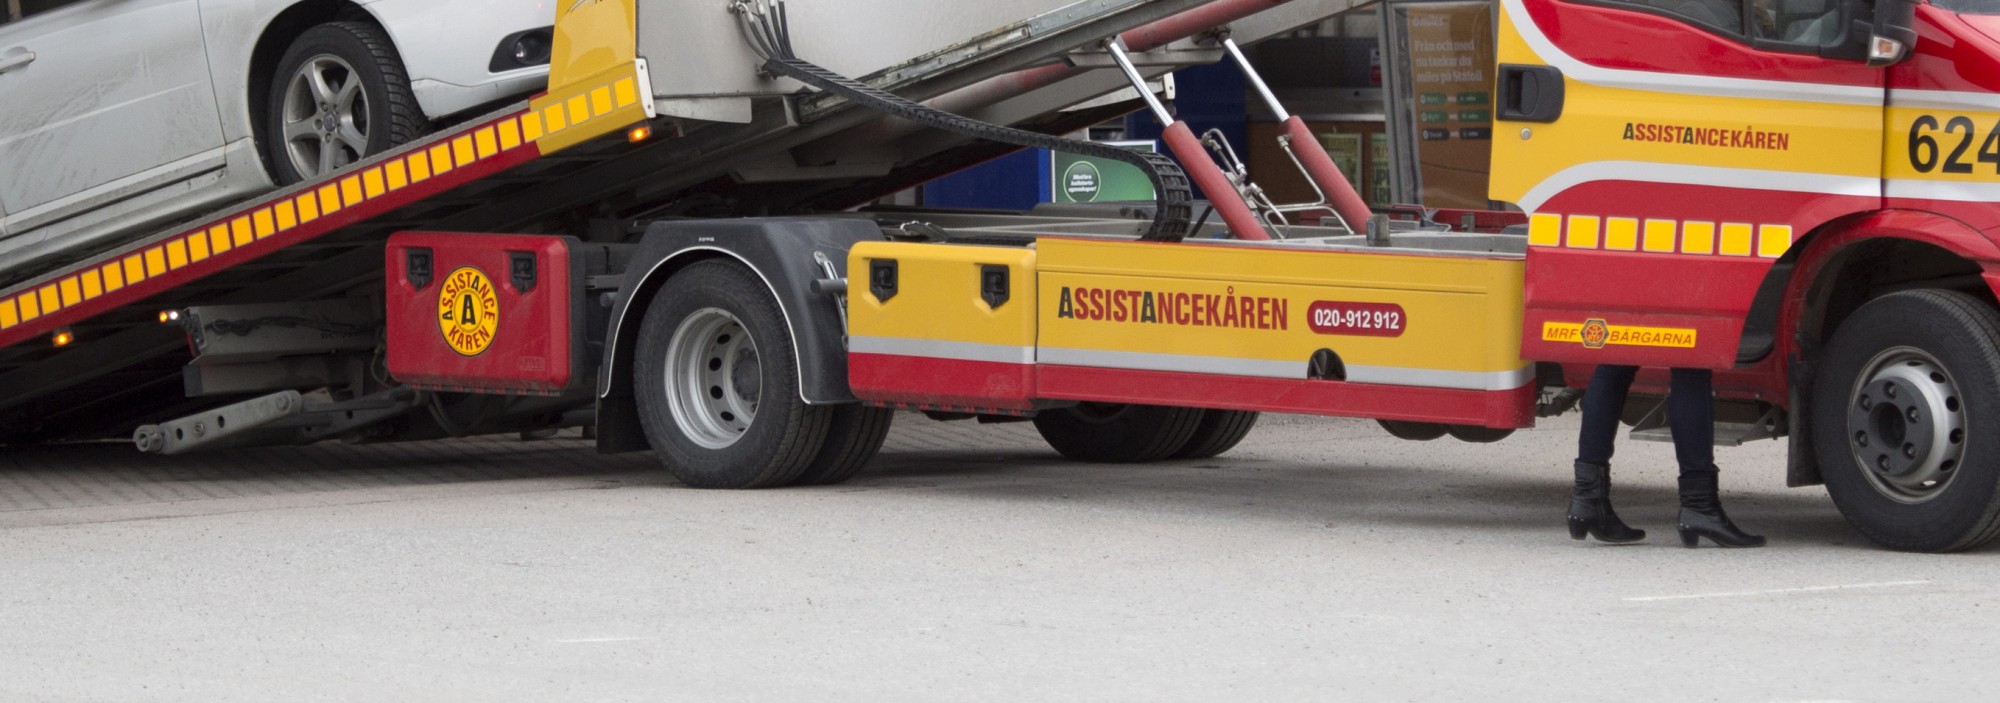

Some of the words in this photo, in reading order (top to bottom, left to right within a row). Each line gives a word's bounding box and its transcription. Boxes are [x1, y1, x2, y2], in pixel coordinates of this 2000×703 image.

[1908, 114, 2000, 175] 624
[442, 272, 495, 321] ASSISTANCE
[1058, 285, 1288, 330] ASSISTANCEKÅREN
[1314, 308, 1371, 328] 020-912
[1374, 311, 1399, 329] 912
[1546, 327, 1578, 340] MRF
[1610, 328, 1692, 345] BÄRGARNA
